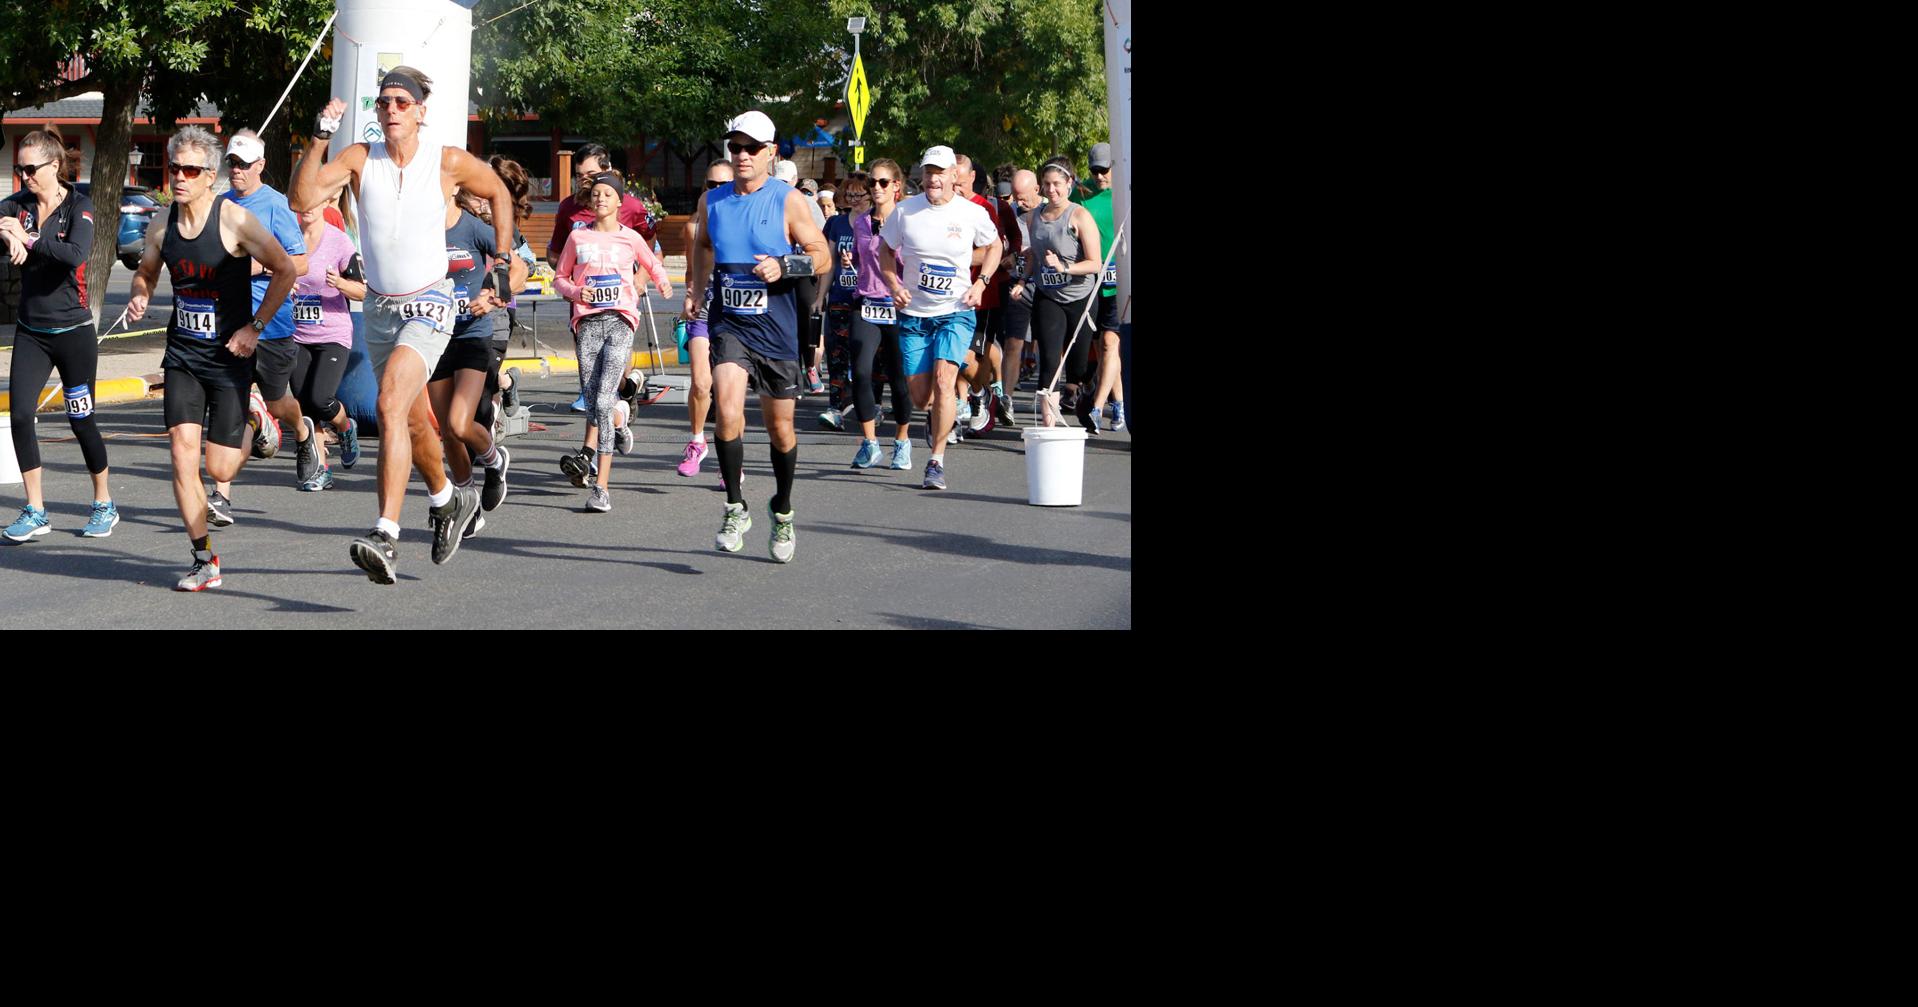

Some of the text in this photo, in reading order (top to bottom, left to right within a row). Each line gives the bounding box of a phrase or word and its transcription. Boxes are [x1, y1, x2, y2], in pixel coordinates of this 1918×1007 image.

[920, 274, 953, 291] 9122
[724, 288, 764, 307] 9022
[179, 310, 211, 331] 9114
[403, 302, 445, 323] 9123
[864, 305, 894, 319] 9121
